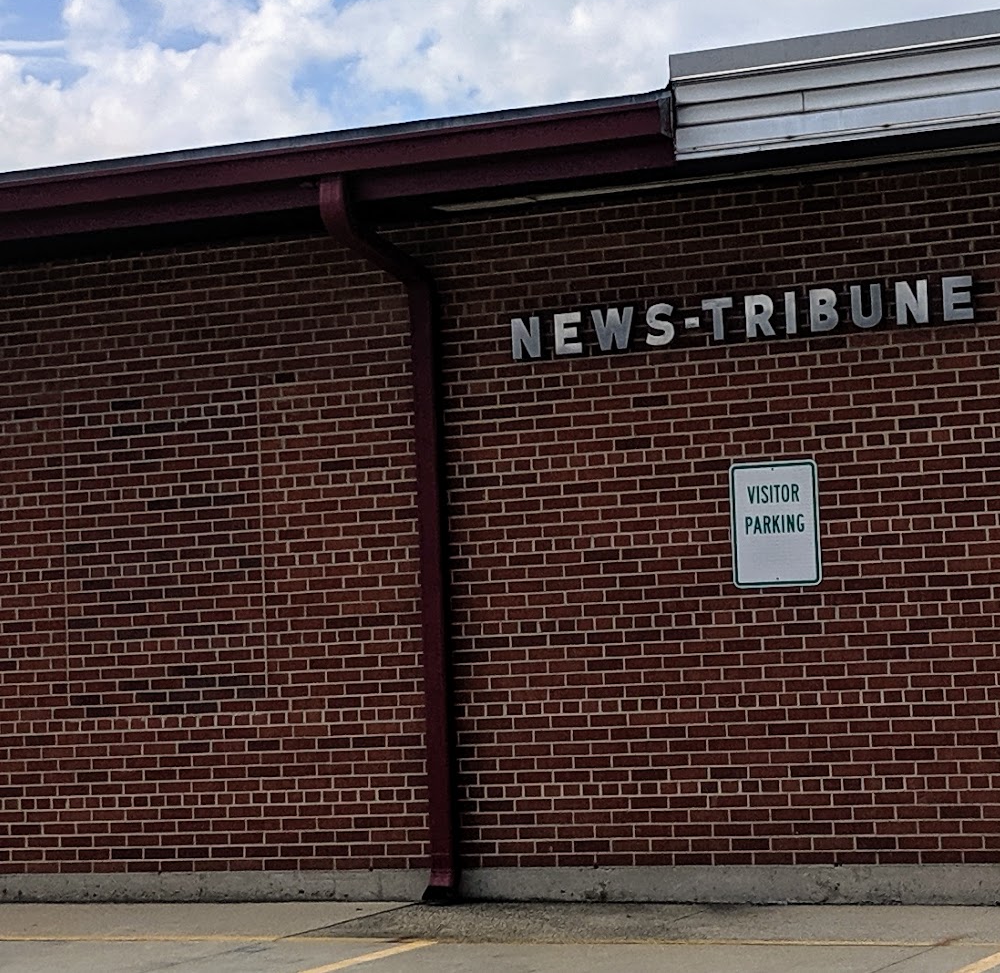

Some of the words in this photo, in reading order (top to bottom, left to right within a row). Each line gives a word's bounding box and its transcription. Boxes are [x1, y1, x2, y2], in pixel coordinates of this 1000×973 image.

[510, 275, 975, 360] NEWS-TRIBUNE
[747, 483, 800, 505] VISITOR
[745, 514, 805, 535] PARKING
